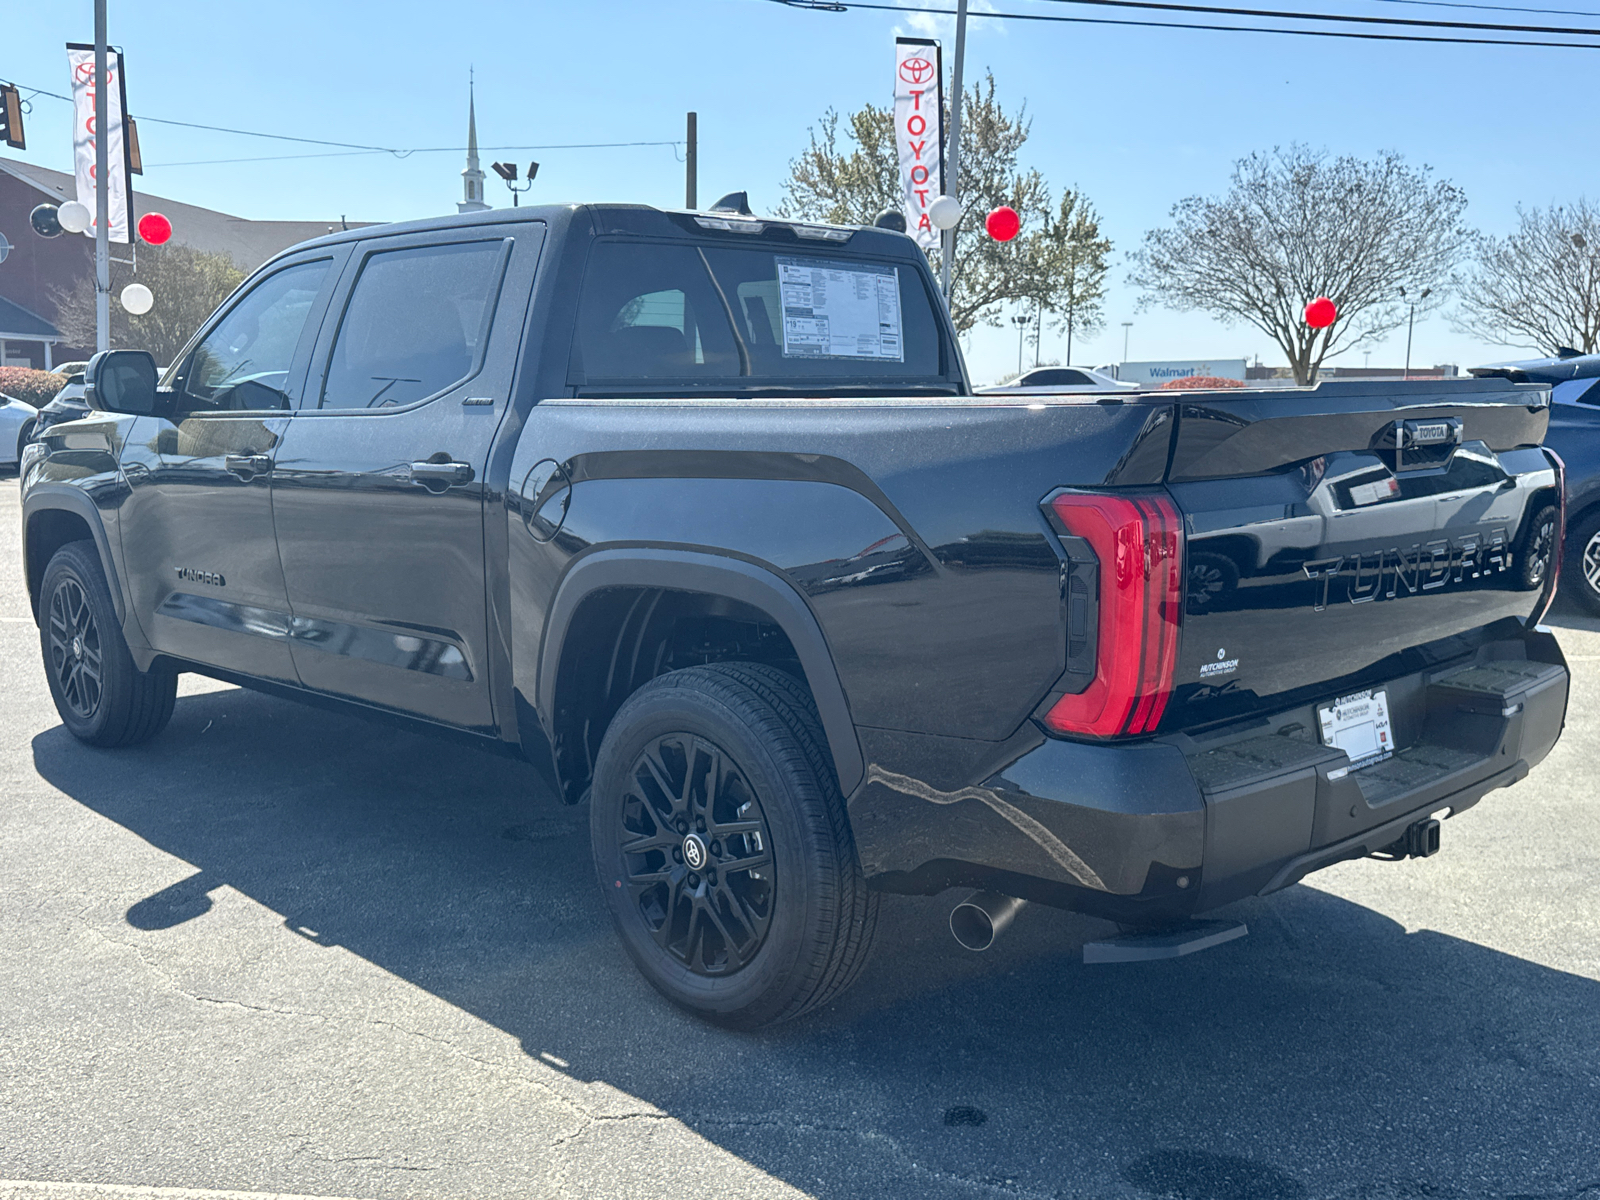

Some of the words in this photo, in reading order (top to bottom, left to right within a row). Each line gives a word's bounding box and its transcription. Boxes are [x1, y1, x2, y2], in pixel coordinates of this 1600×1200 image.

[907, 90, 931, 232] TOYOTA
[1150, 367, 1195, 378] Walmart
[1420, 426, 1444, 439] TOYOTA
[174, 566, 225, 587] TUNDRA
[1303, 527, 1510, 612] TUNDRA
[1200, 659, 1239, 673] HUTCHINSON
